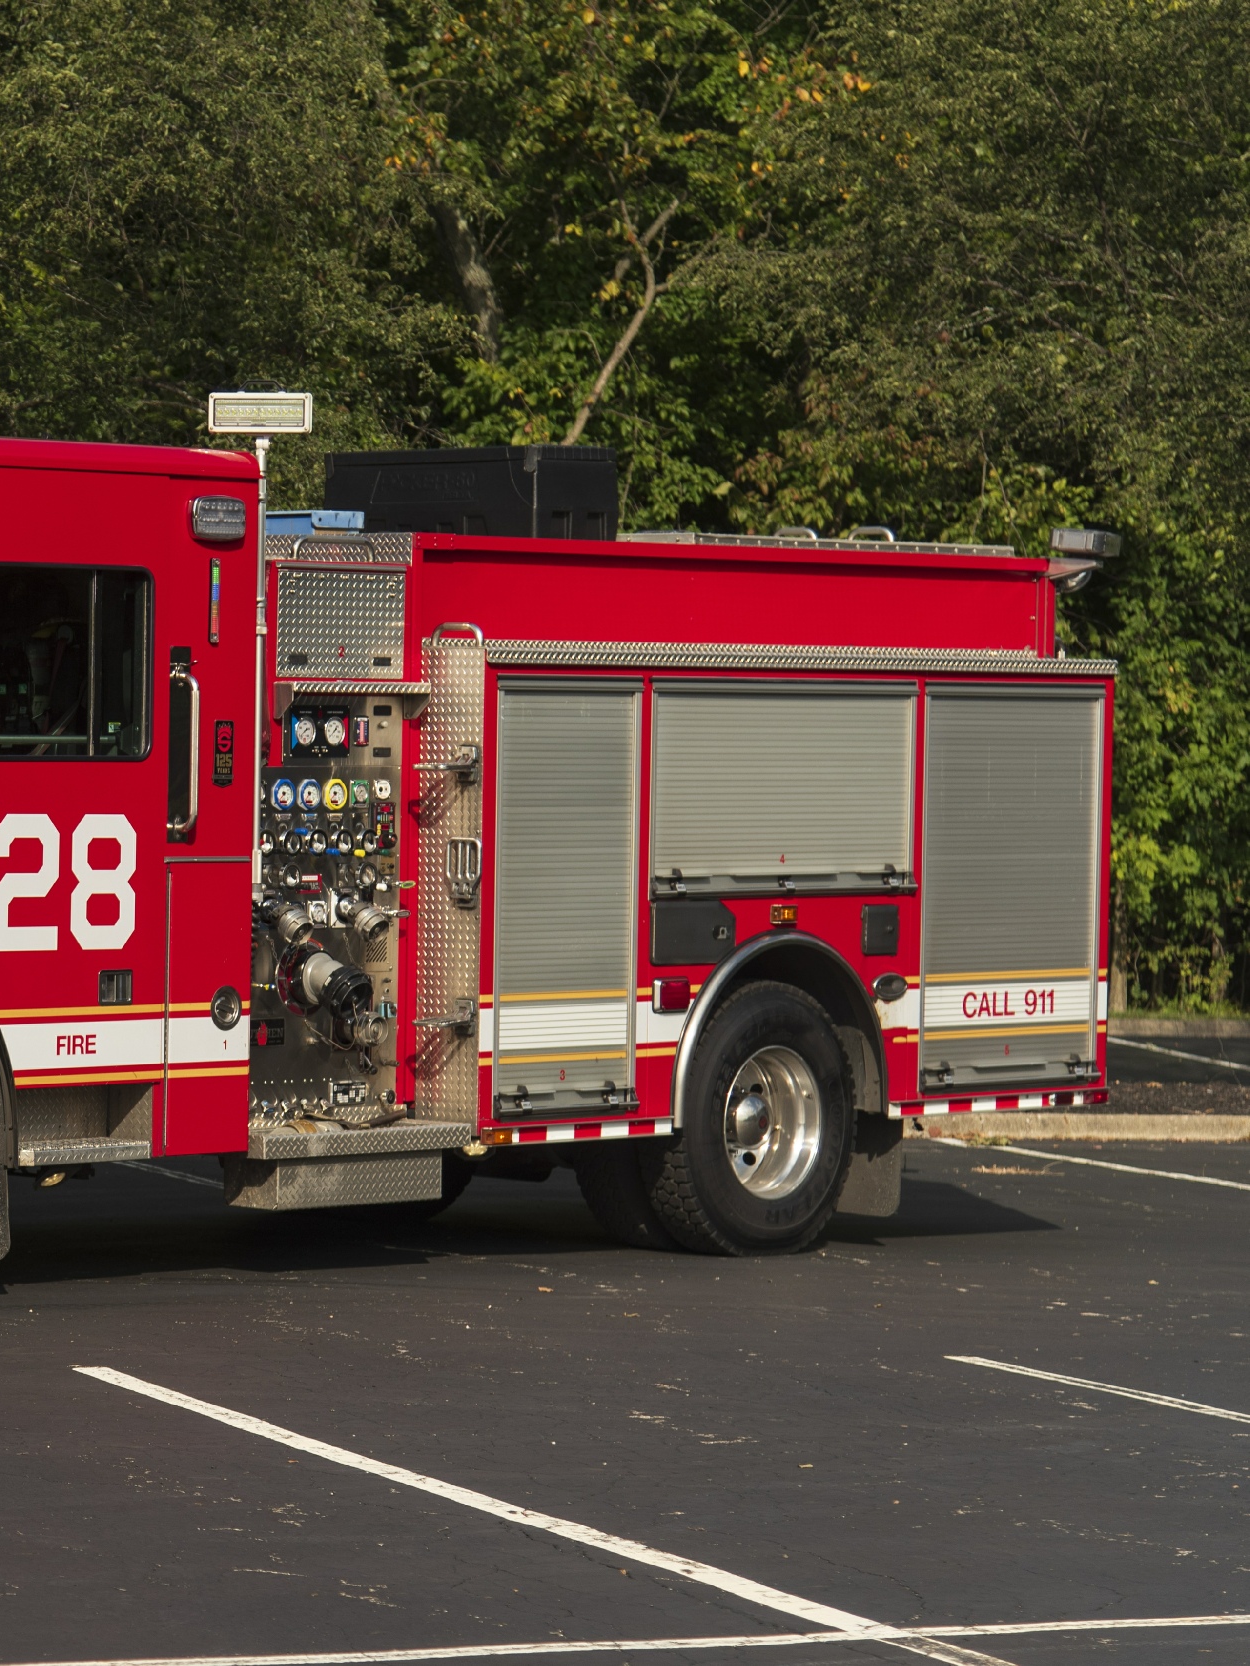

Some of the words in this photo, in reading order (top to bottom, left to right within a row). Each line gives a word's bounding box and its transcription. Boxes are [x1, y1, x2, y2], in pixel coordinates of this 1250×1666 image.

[338, 645, 345, 658] 2
[215, 753, 233, 767] 125
[779, 853, 786, 865] 4
[962, 991, 1016, 1019] CALL
[1023, 988, 1056, 1016] 911
[56, 1034, 97, 1056] FIRE
[222, 1039, 228, 1050] 1
[559, 1069, 566, 1081] 3
